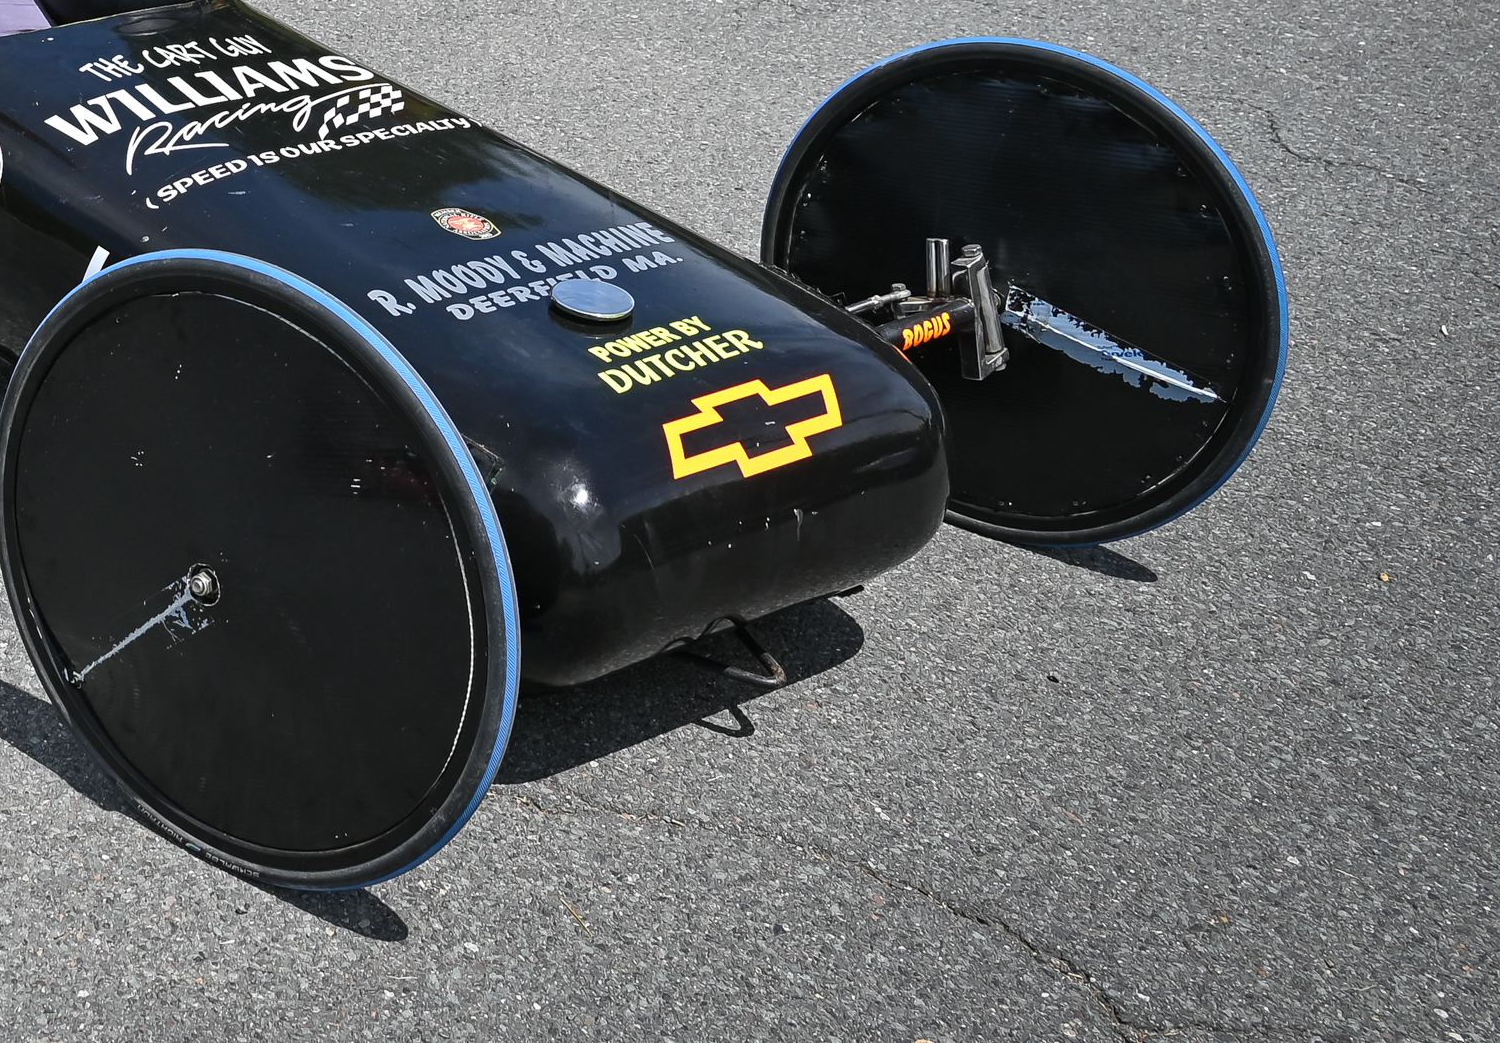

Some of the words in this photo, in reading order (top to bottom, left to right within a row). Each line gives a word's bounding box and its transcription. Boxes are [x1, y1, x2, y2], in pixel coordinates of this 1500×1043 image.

[79, 54, 144, 83] THE
[142, 40, 217, 70] CART
[208, 34, 272, 57] GUY
[43, 54, 375, 147] WILLIAMS
[125, 83, 392, 176] Racing
[246, 150, 280, 168] IS
[277, 138, 343, 161] OUR
[367, 289, 416, 316] R.
[404, 254, 521, 304] MOODY
[511, 250, 547, 273] &
[535, 222, 675, 267] MACHINE
[622, 251, 684, 273] MA.
[586, 324, 682, 365] POWER
[670, 314, 711, 337] BY
[901, 312, 952, 352] BOGUS
[597, 327, 764, 395] DUTCHER
